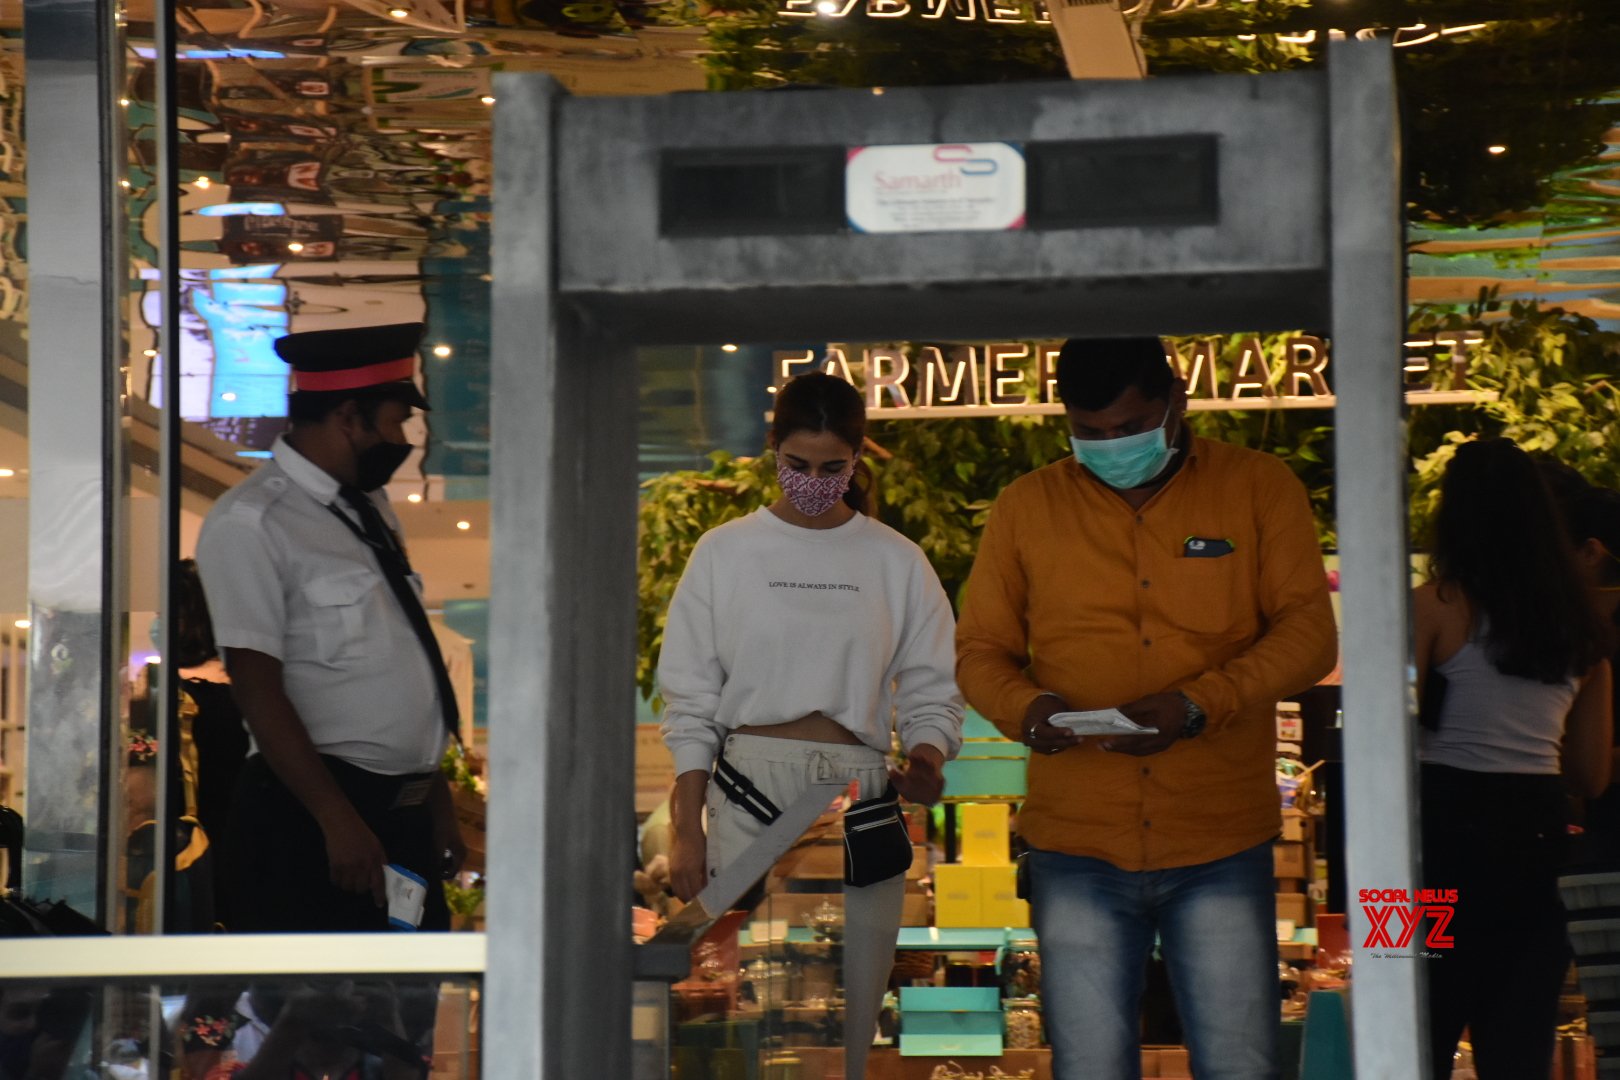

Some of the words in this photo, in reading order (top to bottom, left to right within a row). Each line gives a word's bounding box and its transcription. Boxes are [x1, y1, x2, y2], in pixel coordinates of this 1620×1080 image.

[874, 170, 962, 190] Samarth
[798, 582, 827, 590] ALWAYS
[838, 584, 860, 592] STYLE
